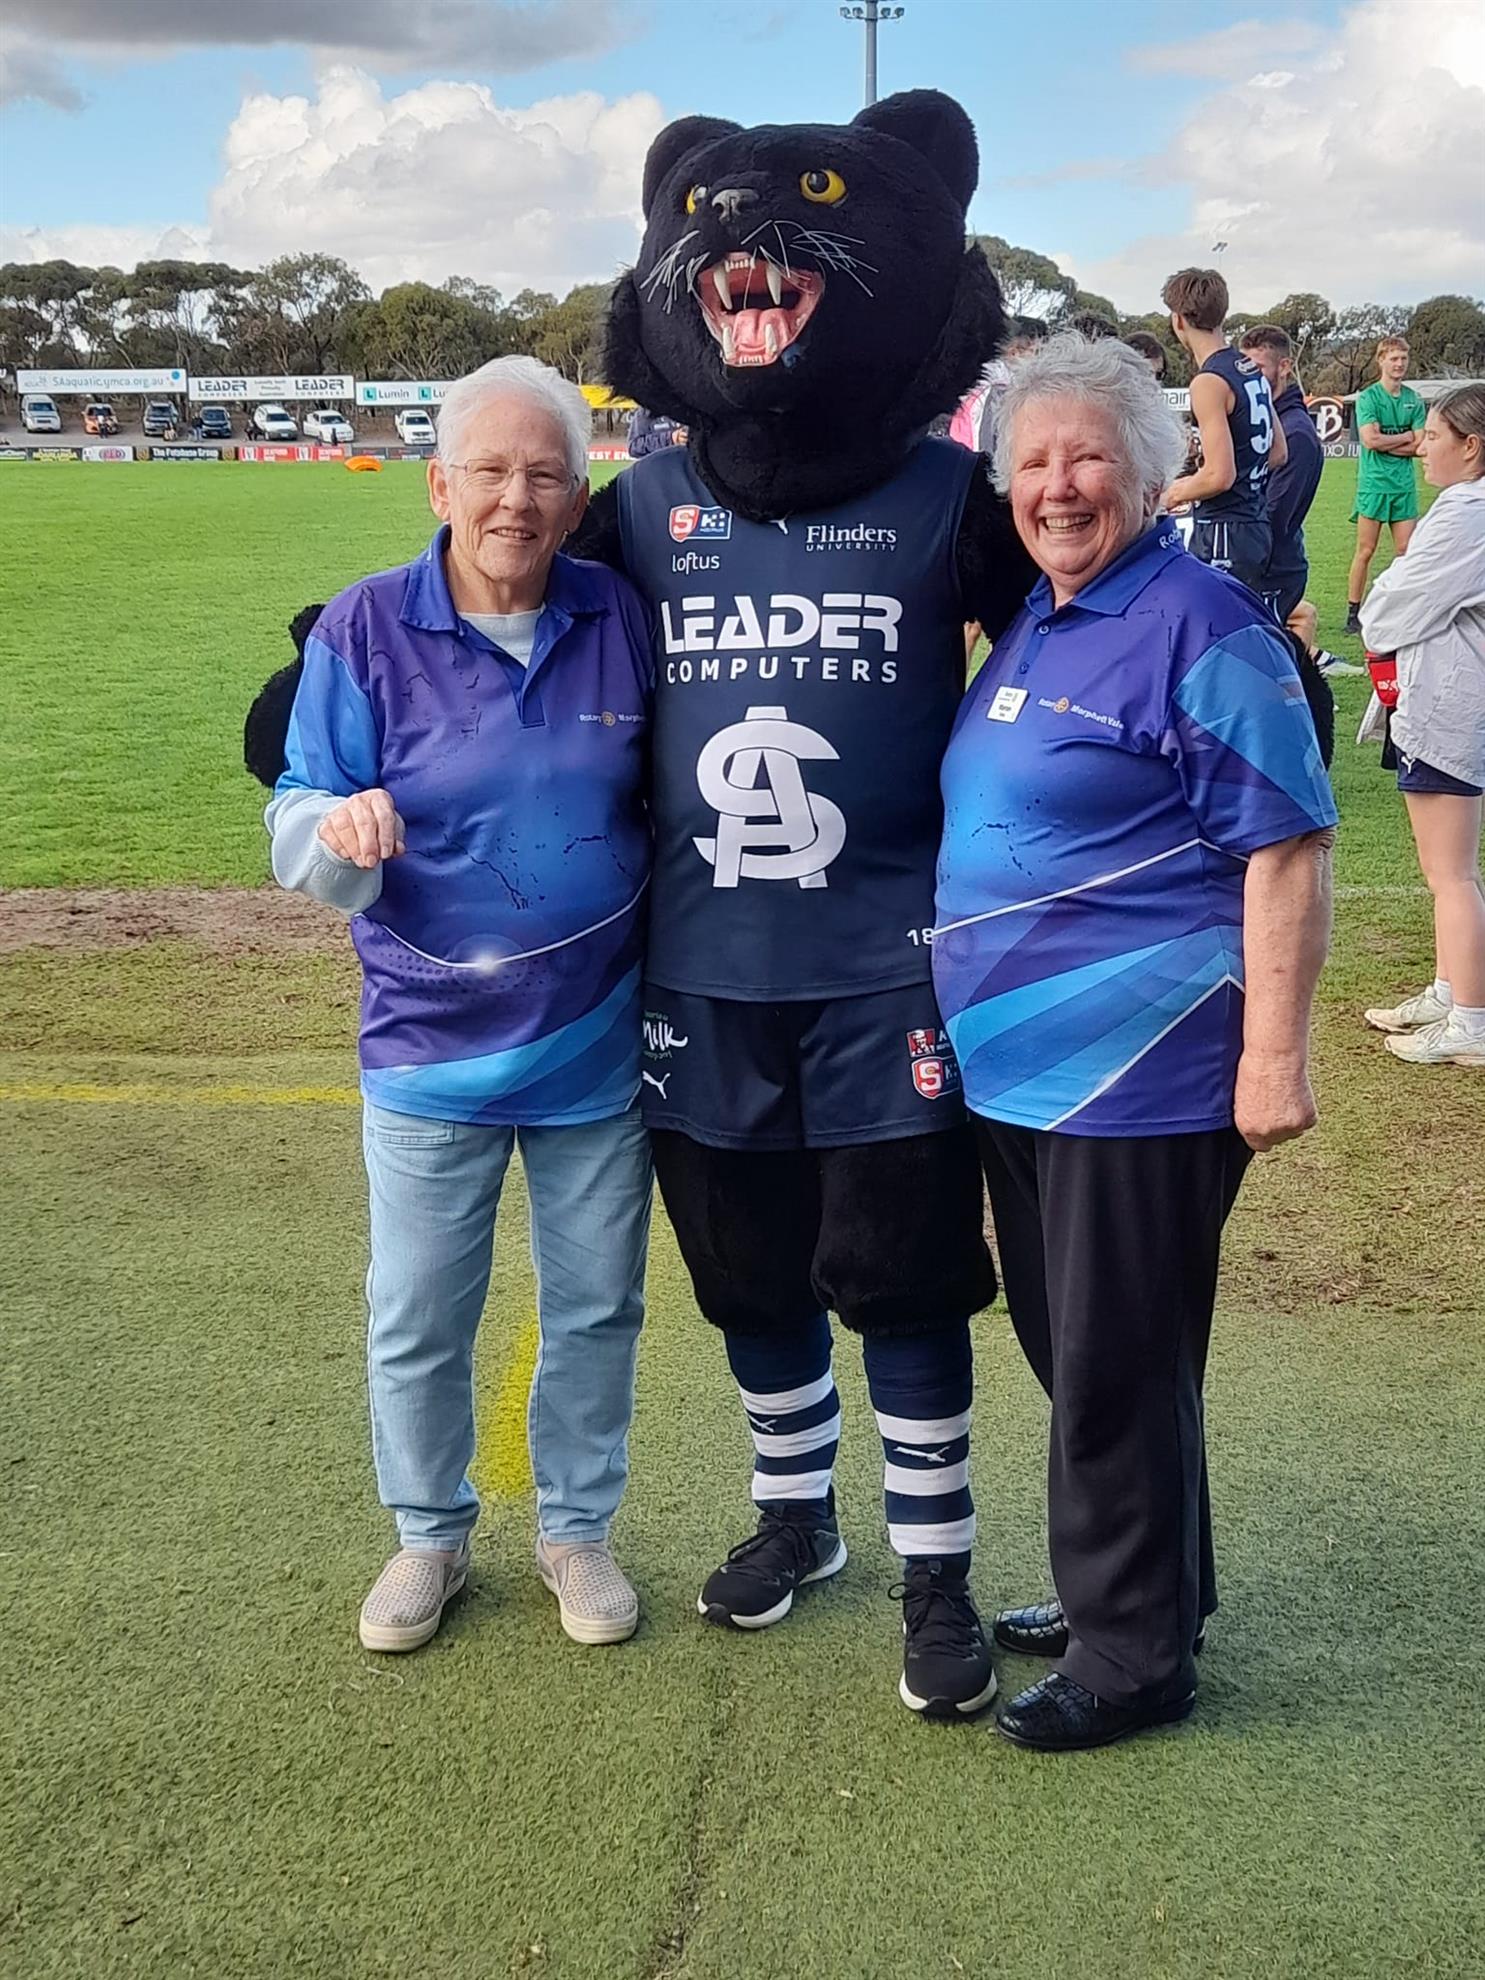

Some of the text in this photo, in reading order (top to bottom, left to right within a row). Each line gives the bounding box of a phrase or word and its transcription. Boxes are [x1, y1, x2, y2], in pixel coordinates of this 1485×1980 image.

[197, 380, 247, 392] LEADER
[295, 379, 345, 391] LEADER
[378, 388, 410, 399] Lumin
[806, 523, 897, 543] Flinders
[806, 543, 896, 551] UNIVERSITY
[672, 552, 720, 575] loftus
[661, 593, 903, 654] LEADER
[667, 656, 898, 683] COMPUTERS
